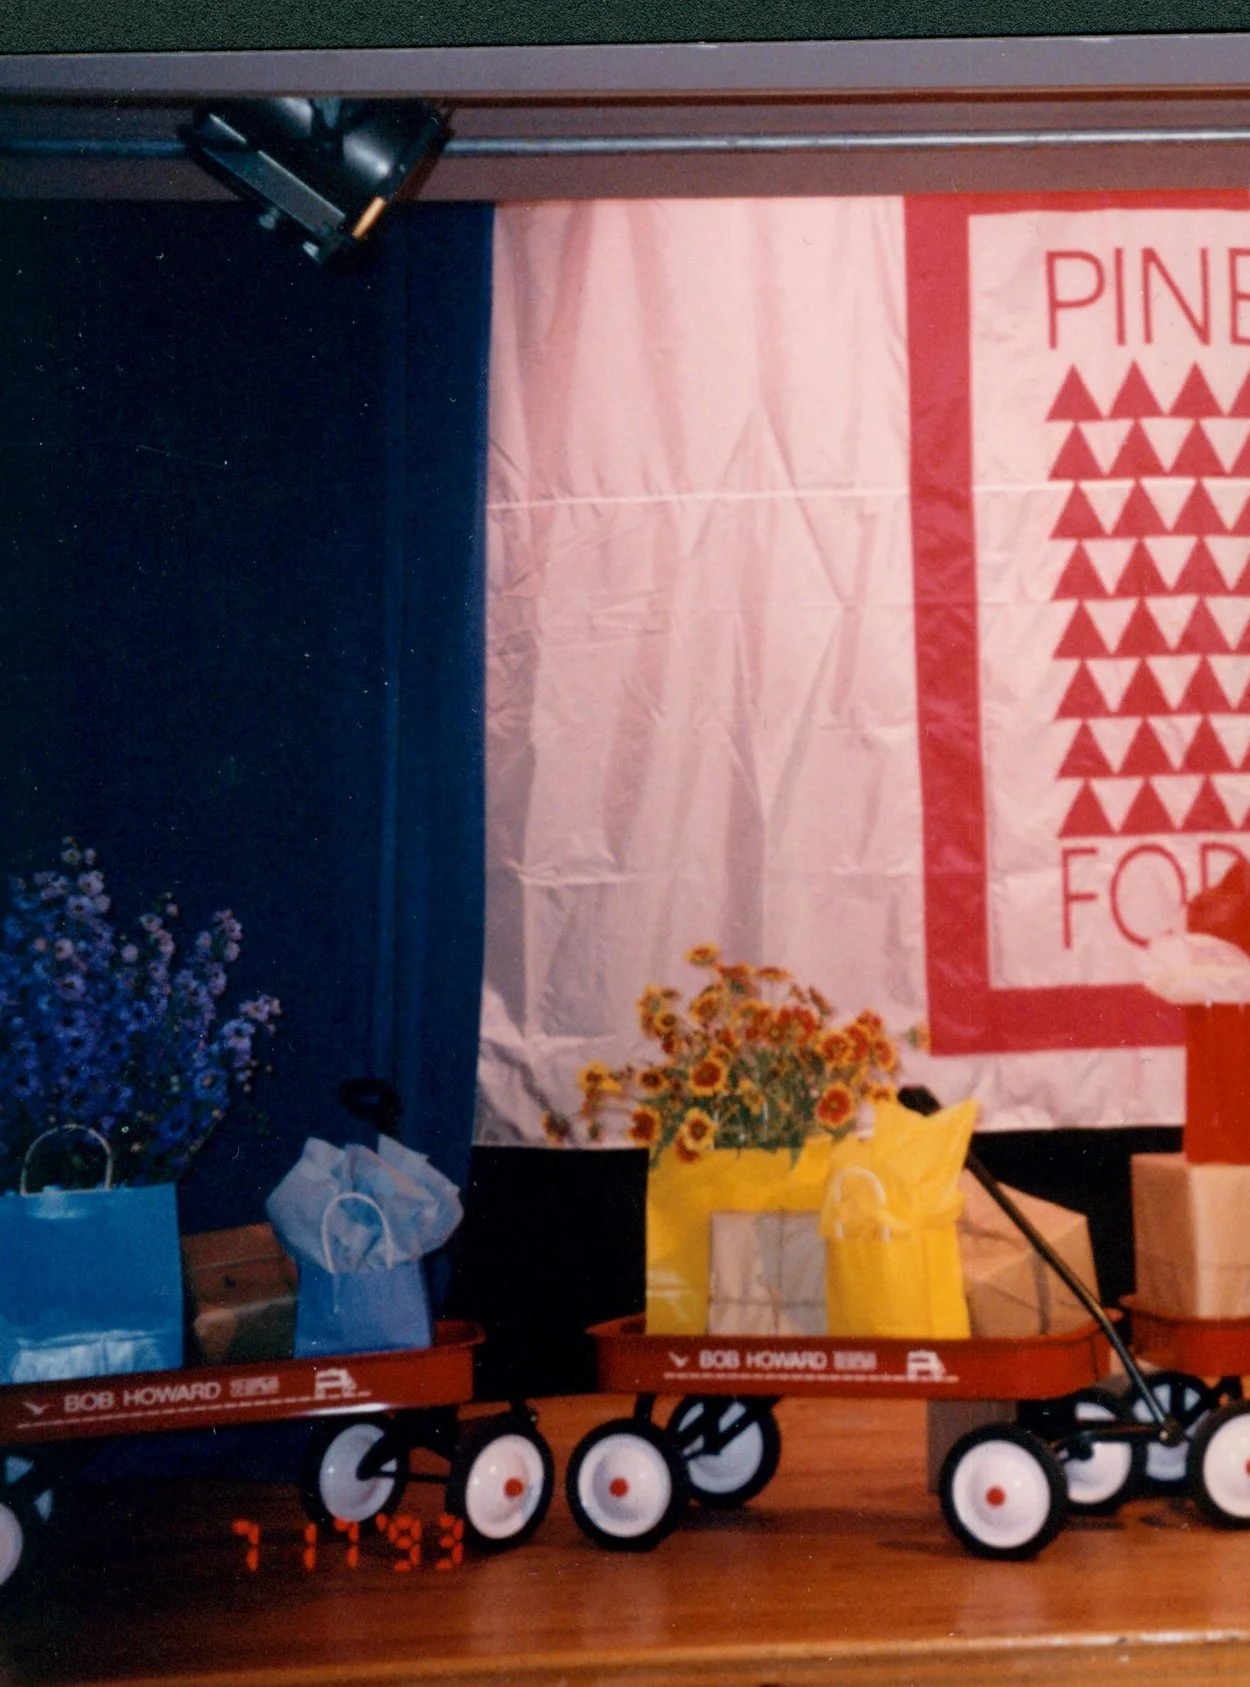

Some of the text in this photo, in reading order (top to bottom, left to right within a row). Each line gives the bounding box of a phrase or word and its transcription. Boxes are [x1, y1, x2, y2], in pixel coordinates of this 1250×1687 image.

[699, 1349, 741, 1371] BOB
[745, 1350, 828, 1372] HOWARD
[63, 1390, 116, 1413] BOB
[121, 1380, 223, 1407] HOWARD
